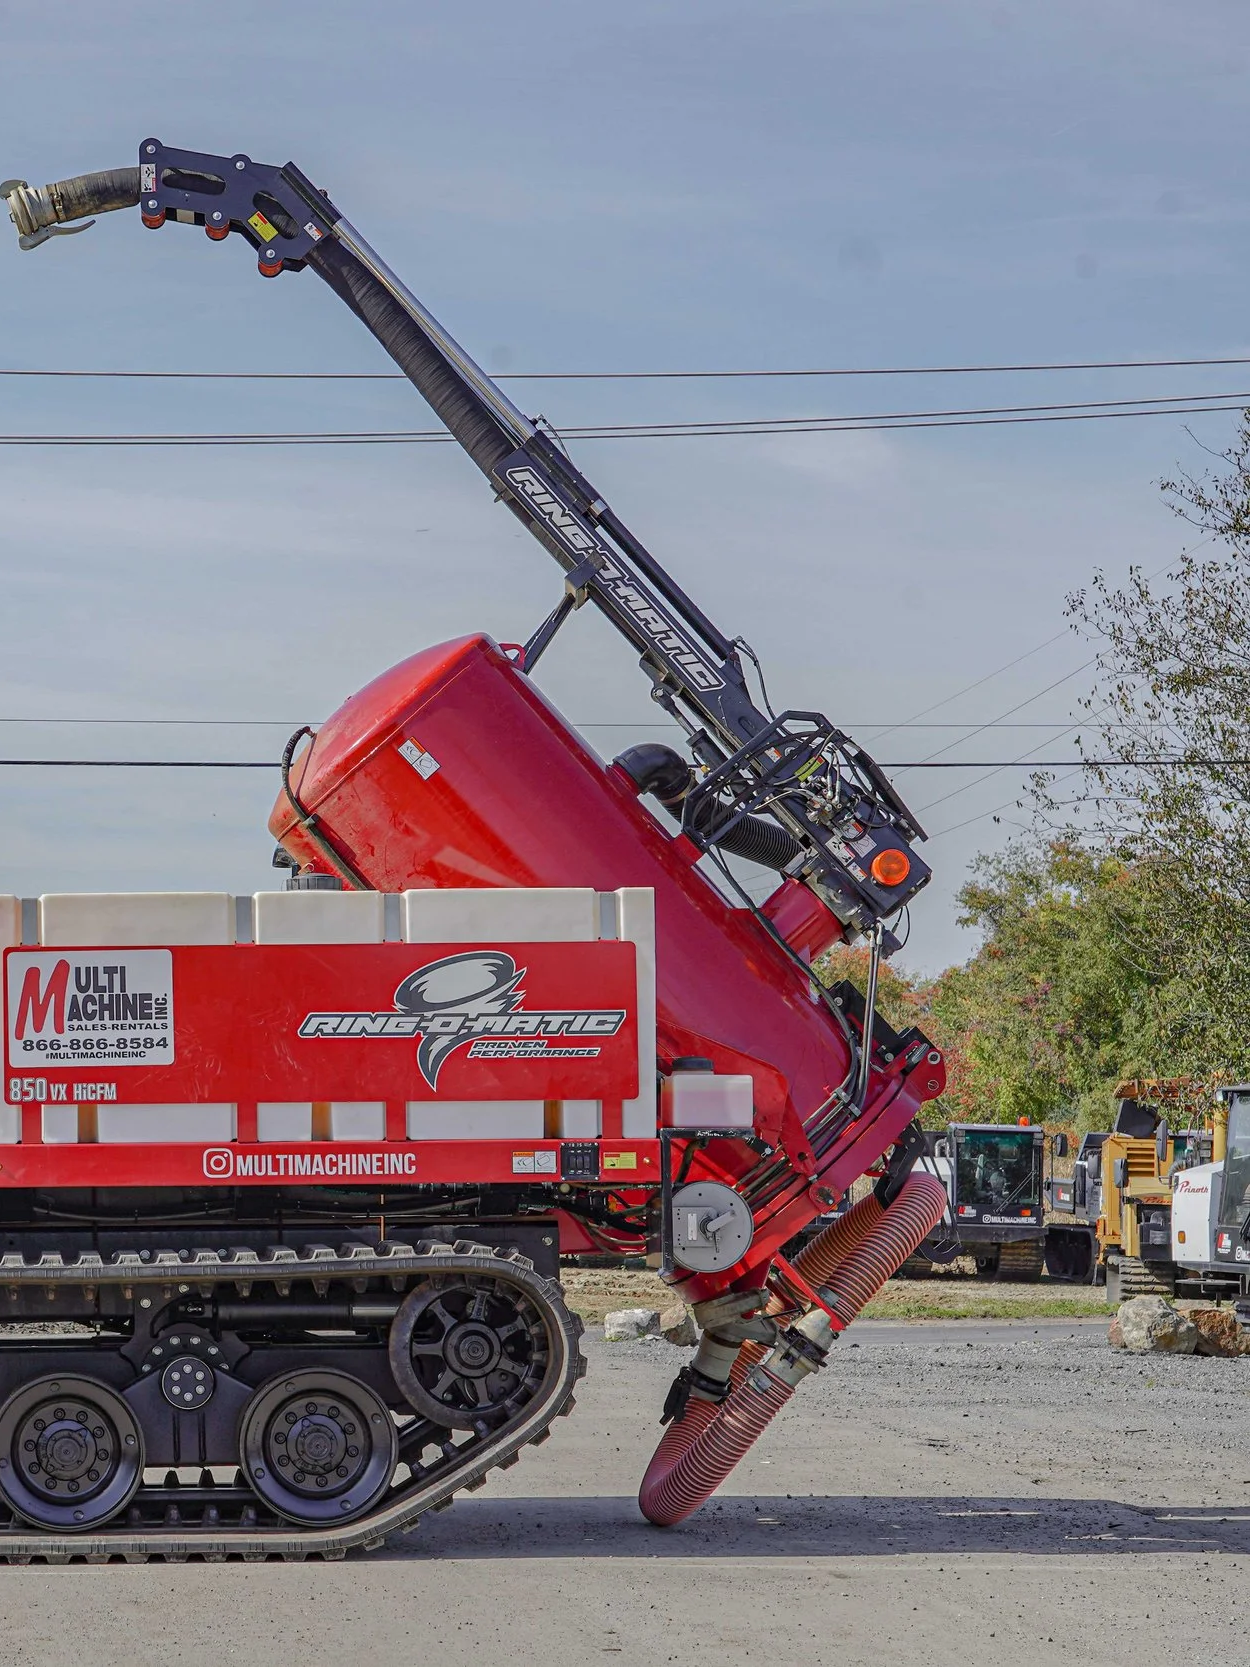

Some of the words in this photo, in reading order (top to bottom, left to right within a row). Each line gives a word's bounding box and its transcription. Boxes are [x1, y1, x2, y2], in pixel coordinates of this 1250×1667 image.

[67, 1022, 169, 1032] SALES-RENTALS
[299, 1011, 626, 1037] RING-O-MATIC
[22, 1036, 169, 1051] 866-866-8584
[472, 1040, 546, 1049] PROVEN
[468, 1048, 600, 1057] PERFORMANCE
[10, 1077, 48, 1102] 850
[50, 1083, 67, 1101] VX
[73, 1082, 117, 1101] HiCFM
[236, 1153, 417, 1176] MULTIMACHINEINC
[1179, 1180, 1209, 1193] Prinoth
